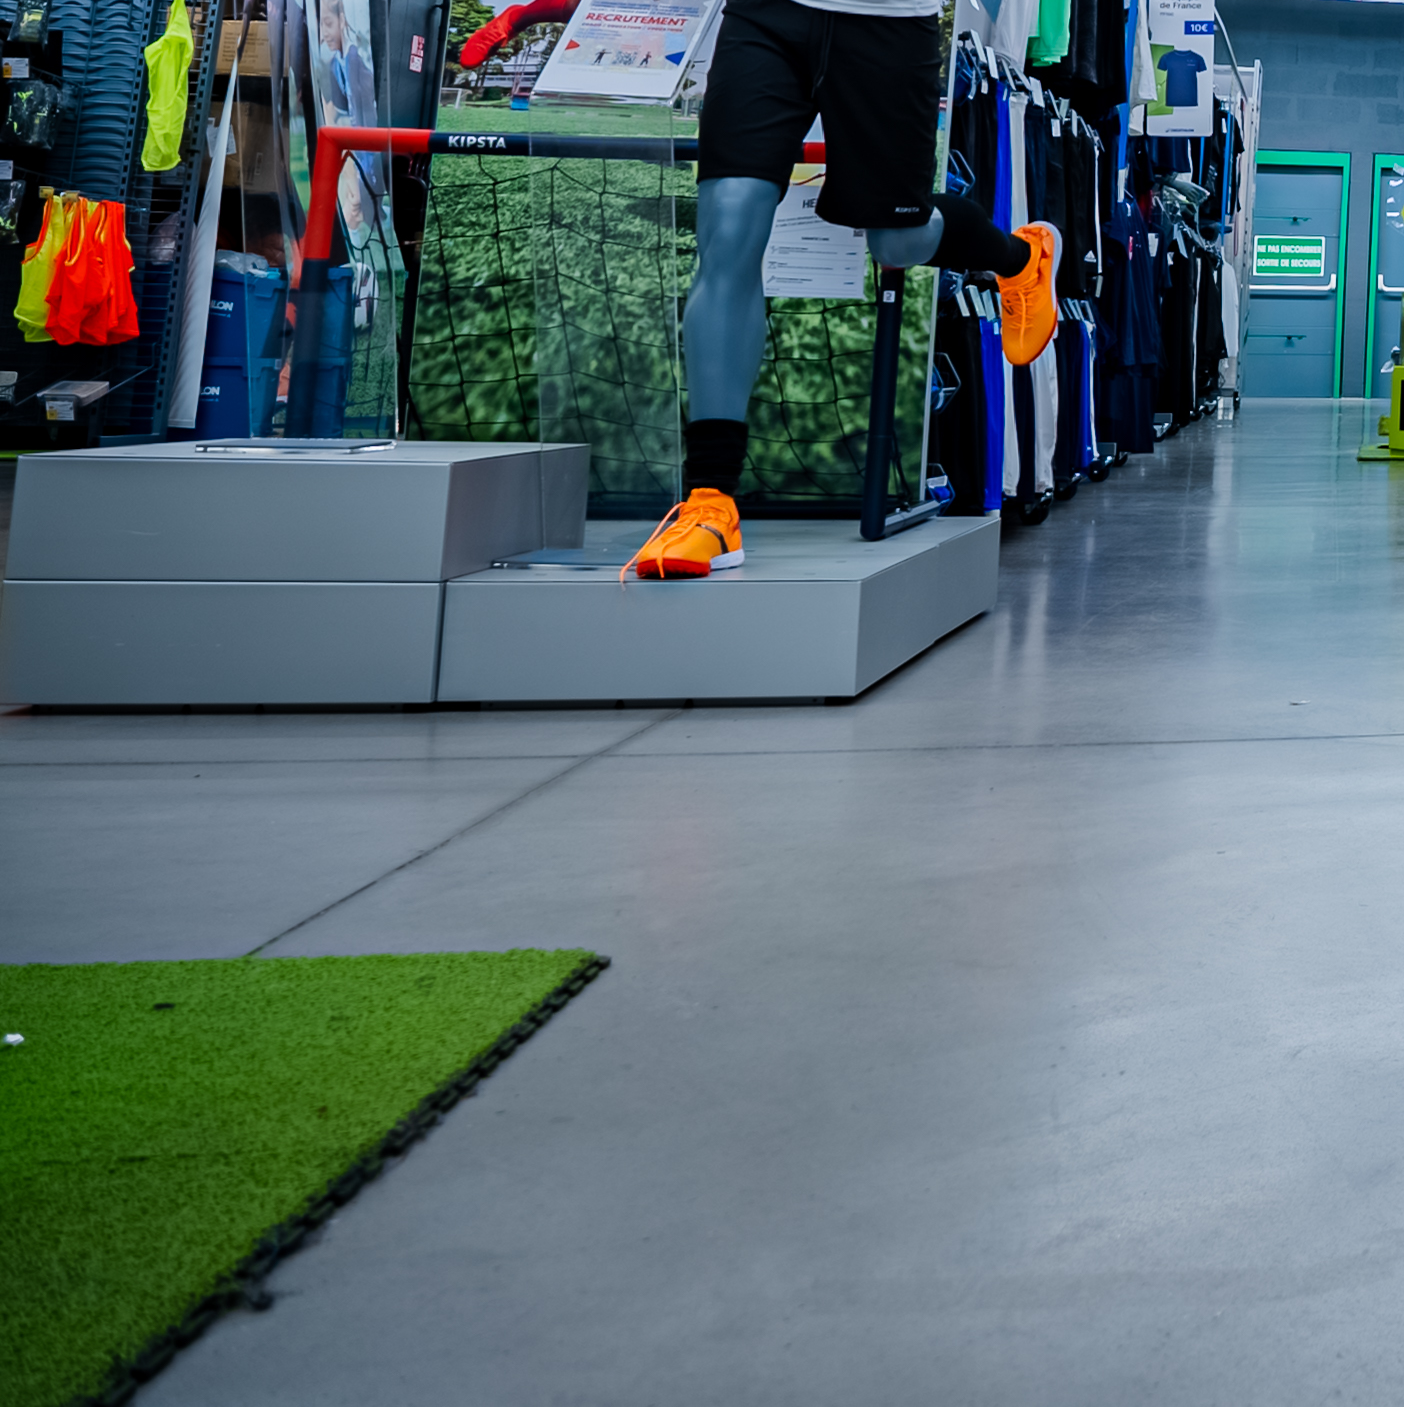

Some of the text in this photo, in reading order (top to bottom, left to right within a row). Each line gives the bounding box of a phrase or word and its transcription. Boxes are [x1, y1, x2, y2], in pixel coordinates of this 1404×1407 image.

[1172, 2, 1202, 10] France
[585, 12, 689, 27] RECRUTEMENT
[1190, 23, 1209, 33] 10€
[448, 135, 506, 149] KIPSTA
